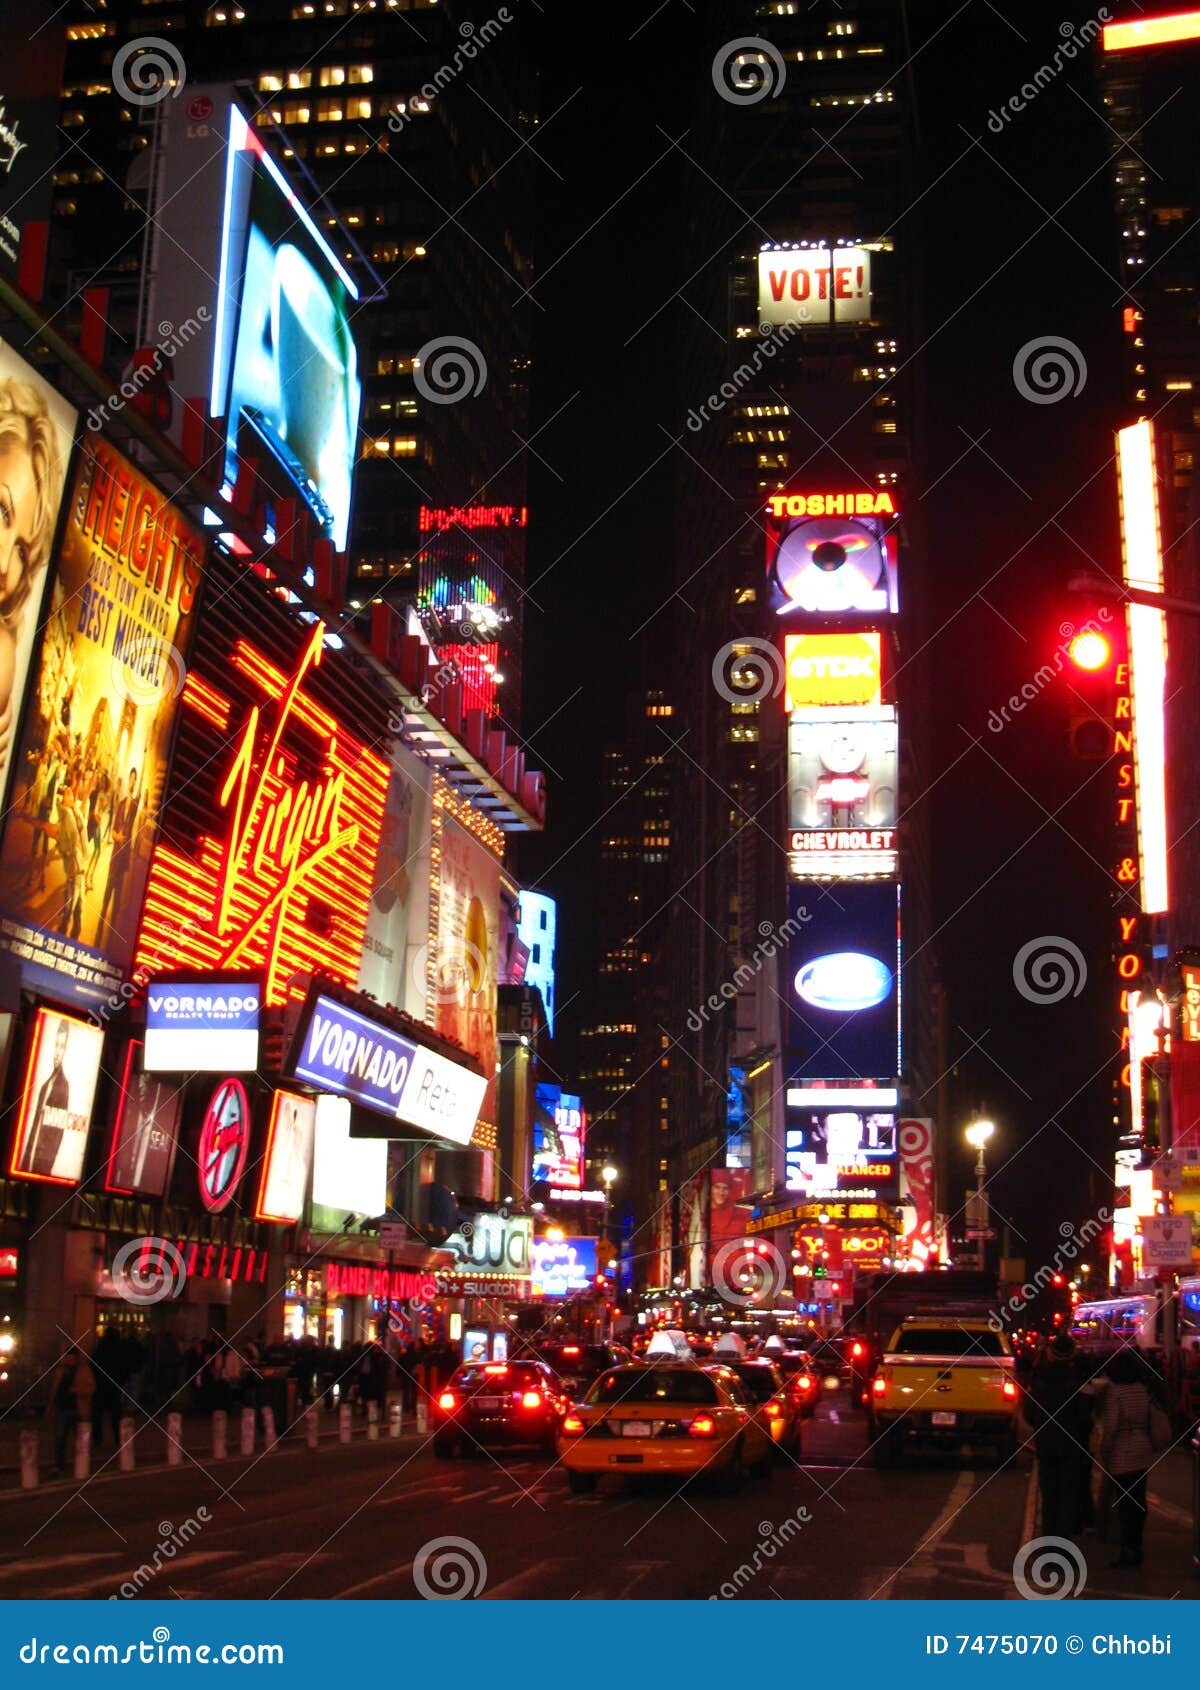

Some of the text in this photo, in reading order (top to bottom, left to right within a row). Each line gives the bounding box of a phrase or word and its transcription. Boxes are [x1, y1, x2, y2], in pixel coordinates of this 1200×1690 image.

[187, 126, 208, 138] LG
[769, 266, 864, 302] VOTE!
[768, 493, 894, 516] TOSHIBA
[82, 448, 205, 615] HEIGHTS
[77, 582, 114, 649] BEST
[810, 655, 874, 678] TDK
[1113, 663, 1134, 822] ERNST
[220, 620, 360, 1007] Virgin
[791, 831, 894, 850] CHEVROLET
[1117, 858, 1138, 881] &
[148, 996, 259, 1012] VORNADO
[307, 1014, 409, 1094] VORNADO
[805, 1187, 877, 1199] Panasonic
[801, 1236, 884, 1255] YOO!
[463, 1280, 517, 1296] swatch
